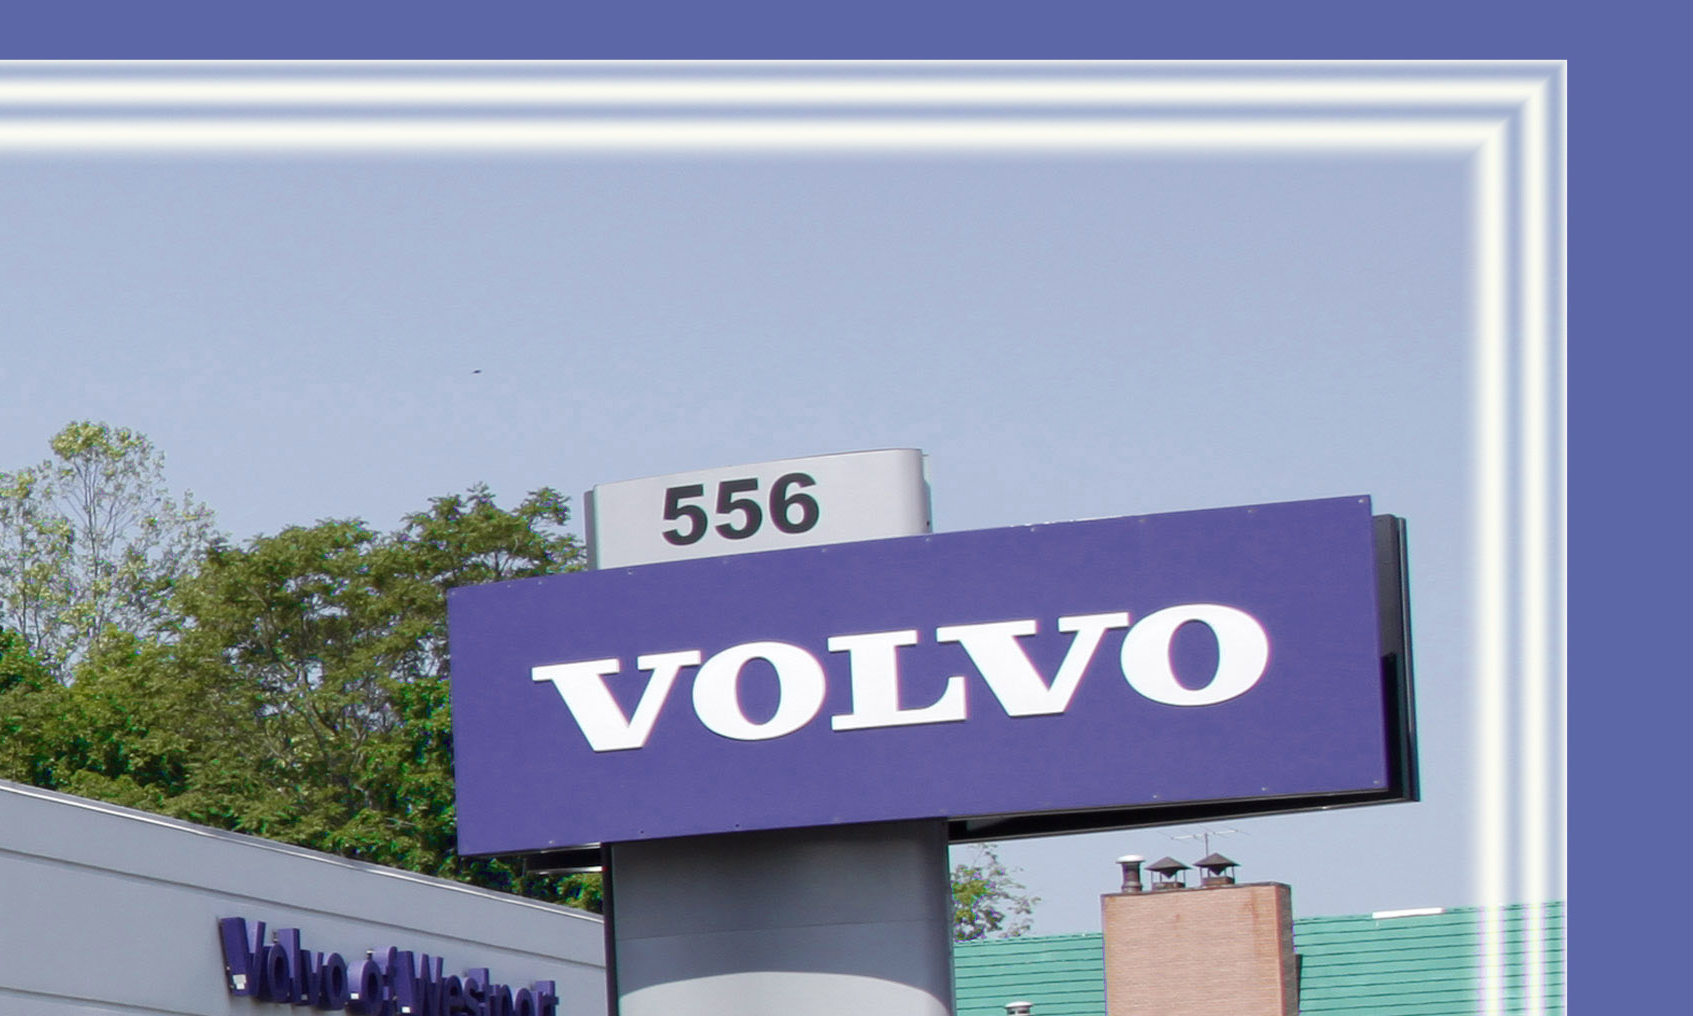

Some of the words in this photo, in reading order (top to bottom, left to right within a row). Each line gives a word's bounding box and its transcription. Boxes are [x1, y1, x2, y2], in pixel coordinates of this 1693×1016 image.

[661, 472, 820, 546] 556
[531, 603, 1269, 752] VOLVO
[218, 916, 348, 1010] Volvo
